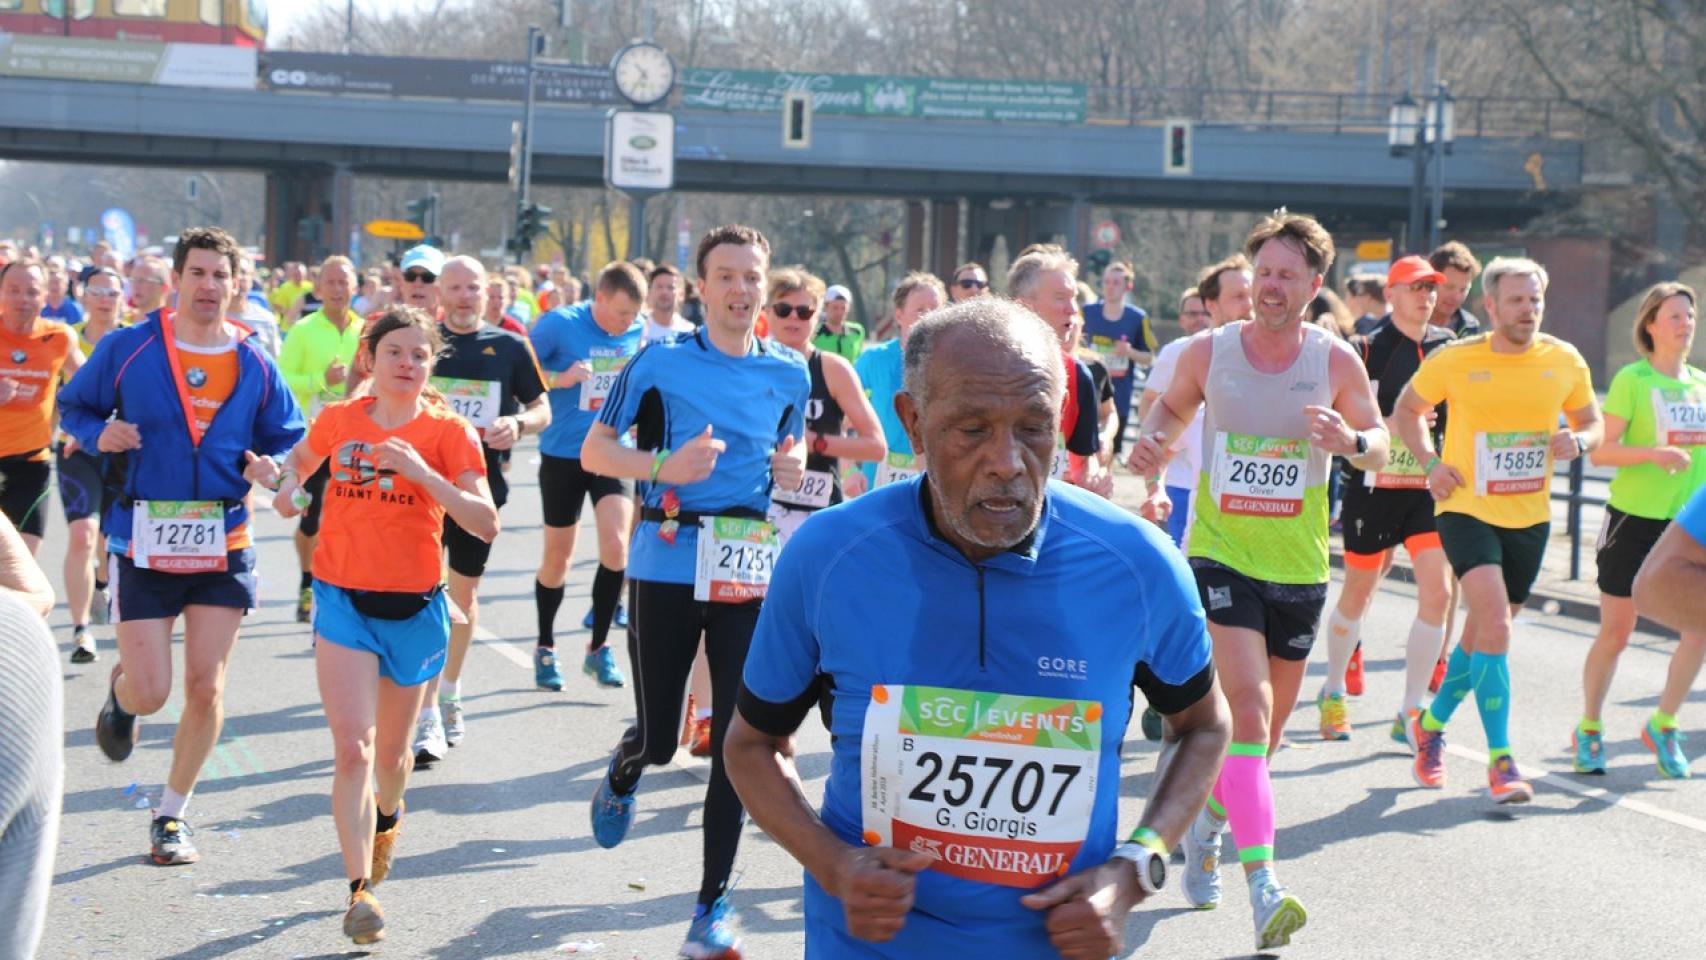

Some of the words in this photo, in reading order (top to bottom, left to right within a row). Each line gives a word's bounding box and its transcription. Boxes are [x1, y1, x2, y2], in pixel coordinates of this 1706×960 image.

[1494, 450, 1545, 471] 15852
[1229, 461, 1299, 486] 26369
[336, 486, 372, 500] GIANT
[380, 492, 415, 505] RACE
[1249, 486, 1274, 495] Oliver
[1243, 501, 1295, 513] GENERALI
[154, 524, 216, 545] 12781
[718, 545, 774, 571] 21251
[1038, 656, 1087, 673] GORE
[920, 699, 967, 725] SCC
[987, 708, 1084, 733] EVENTS
[903, 738, 914, 752] B
[908, 751, 1082, 817] 25707
[936, 808, 956, 828] G.
[965, 811, 1037, 839] Giorgis
[944, 844, 1065, 874] GENERALI
